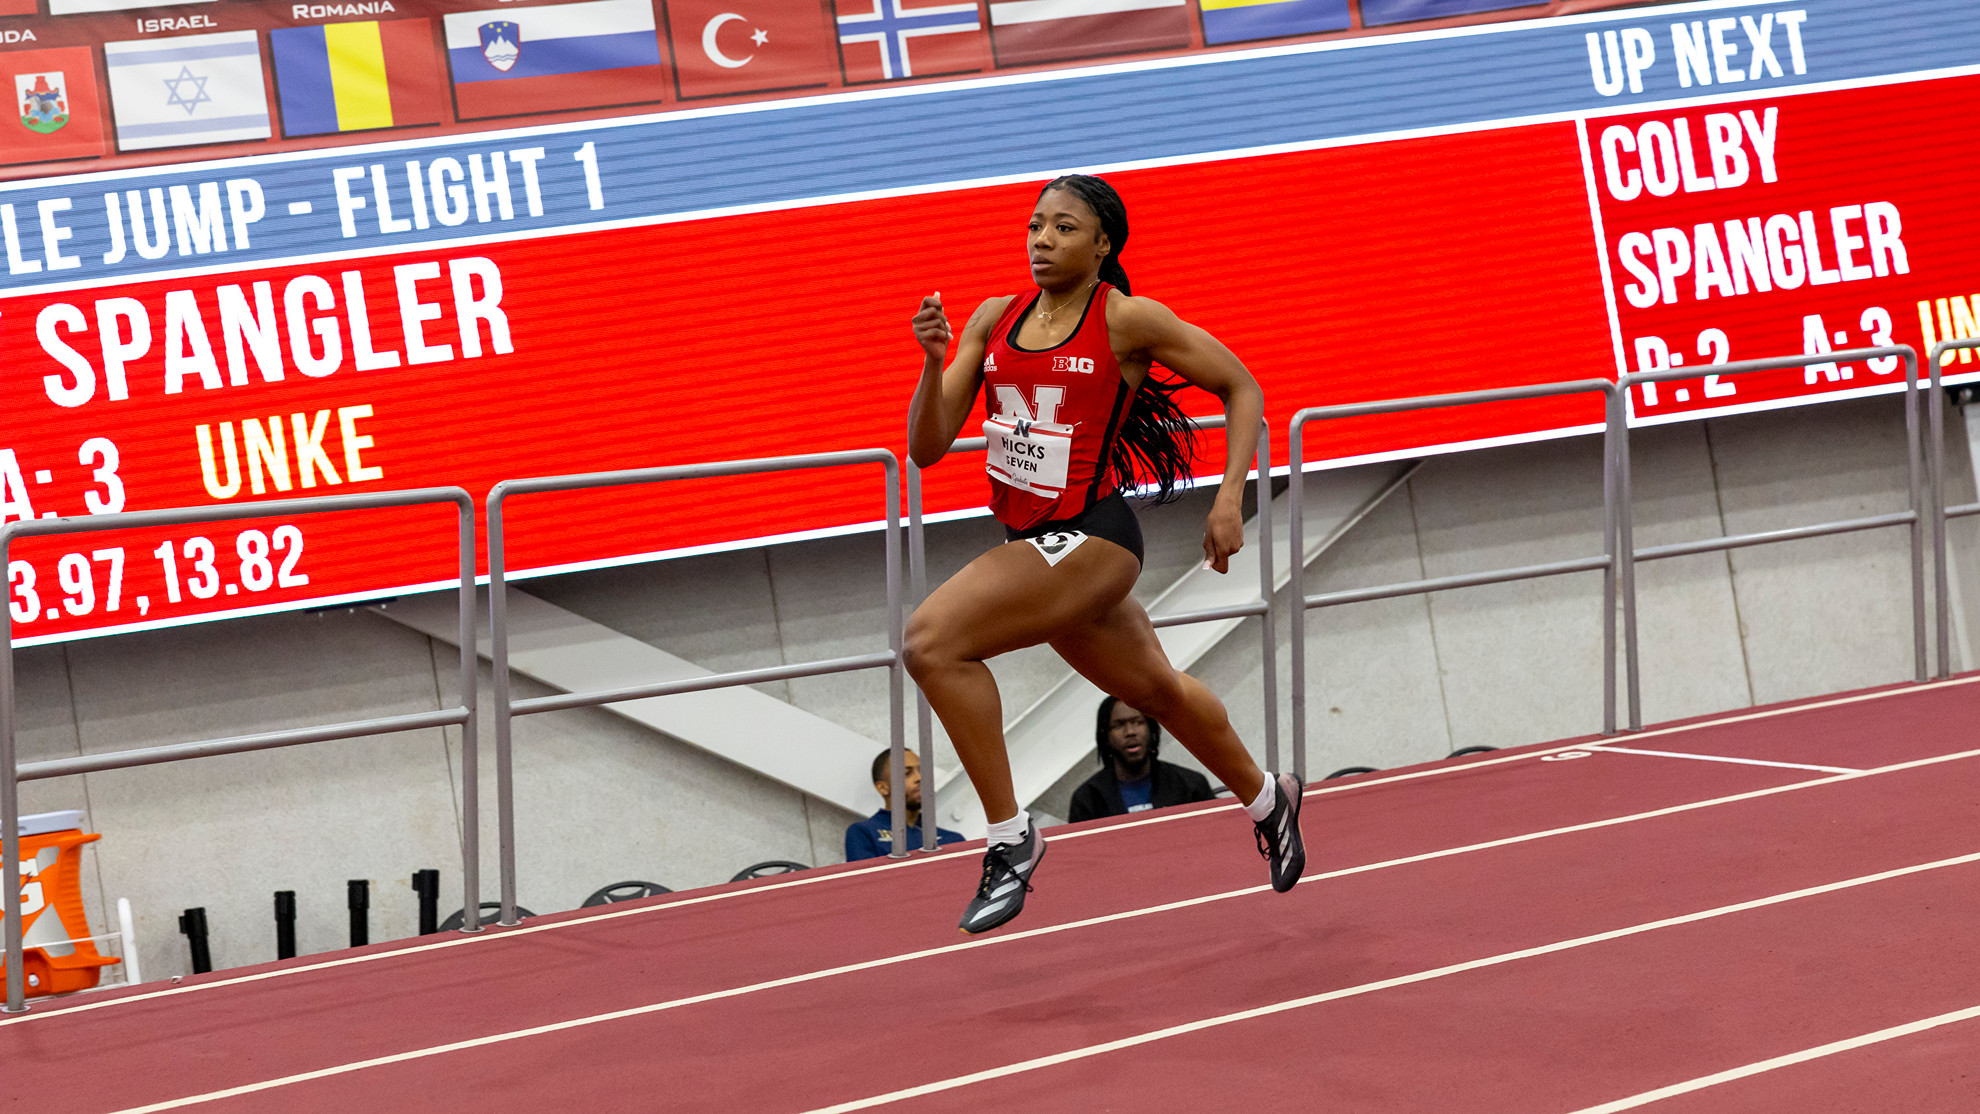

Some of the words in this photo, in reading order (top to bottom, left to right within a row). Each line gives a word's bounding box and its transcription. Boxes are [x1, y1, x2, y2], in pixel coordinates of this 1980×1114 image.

[0, 29, 37, 44] DA
[1586, 27, 1655, 97] UP
[1670, 9, 1808, 89] NEXT
[1600, 106, 1779, 202] COLBY
[0, 197, 82, 275] LE
[102, 178, 266, 265] JUMP
[332, 146, 546, 238] FLIGHT
[574, 141, 605, 210] 1
[1617, 200, 1910, 309] SPANGLER
[36, 255, 515, 408] SPANGLER
[1634, 336, 1690, 406] P:
[1697, 328, 1737, 398] 2
[1803, 314, 1854, 385] A:
[1859, 306, 1898, 375] 3
[993, 383, 1067, 425] N
[1001, 436, 1045, 460] HICKS
[1013, 419, 1032, 438] N
[78, 437, 126, 516] 3
[195, 403, 384, 500] UNKE
[1006, 455, 1038, 473] SEVEN
